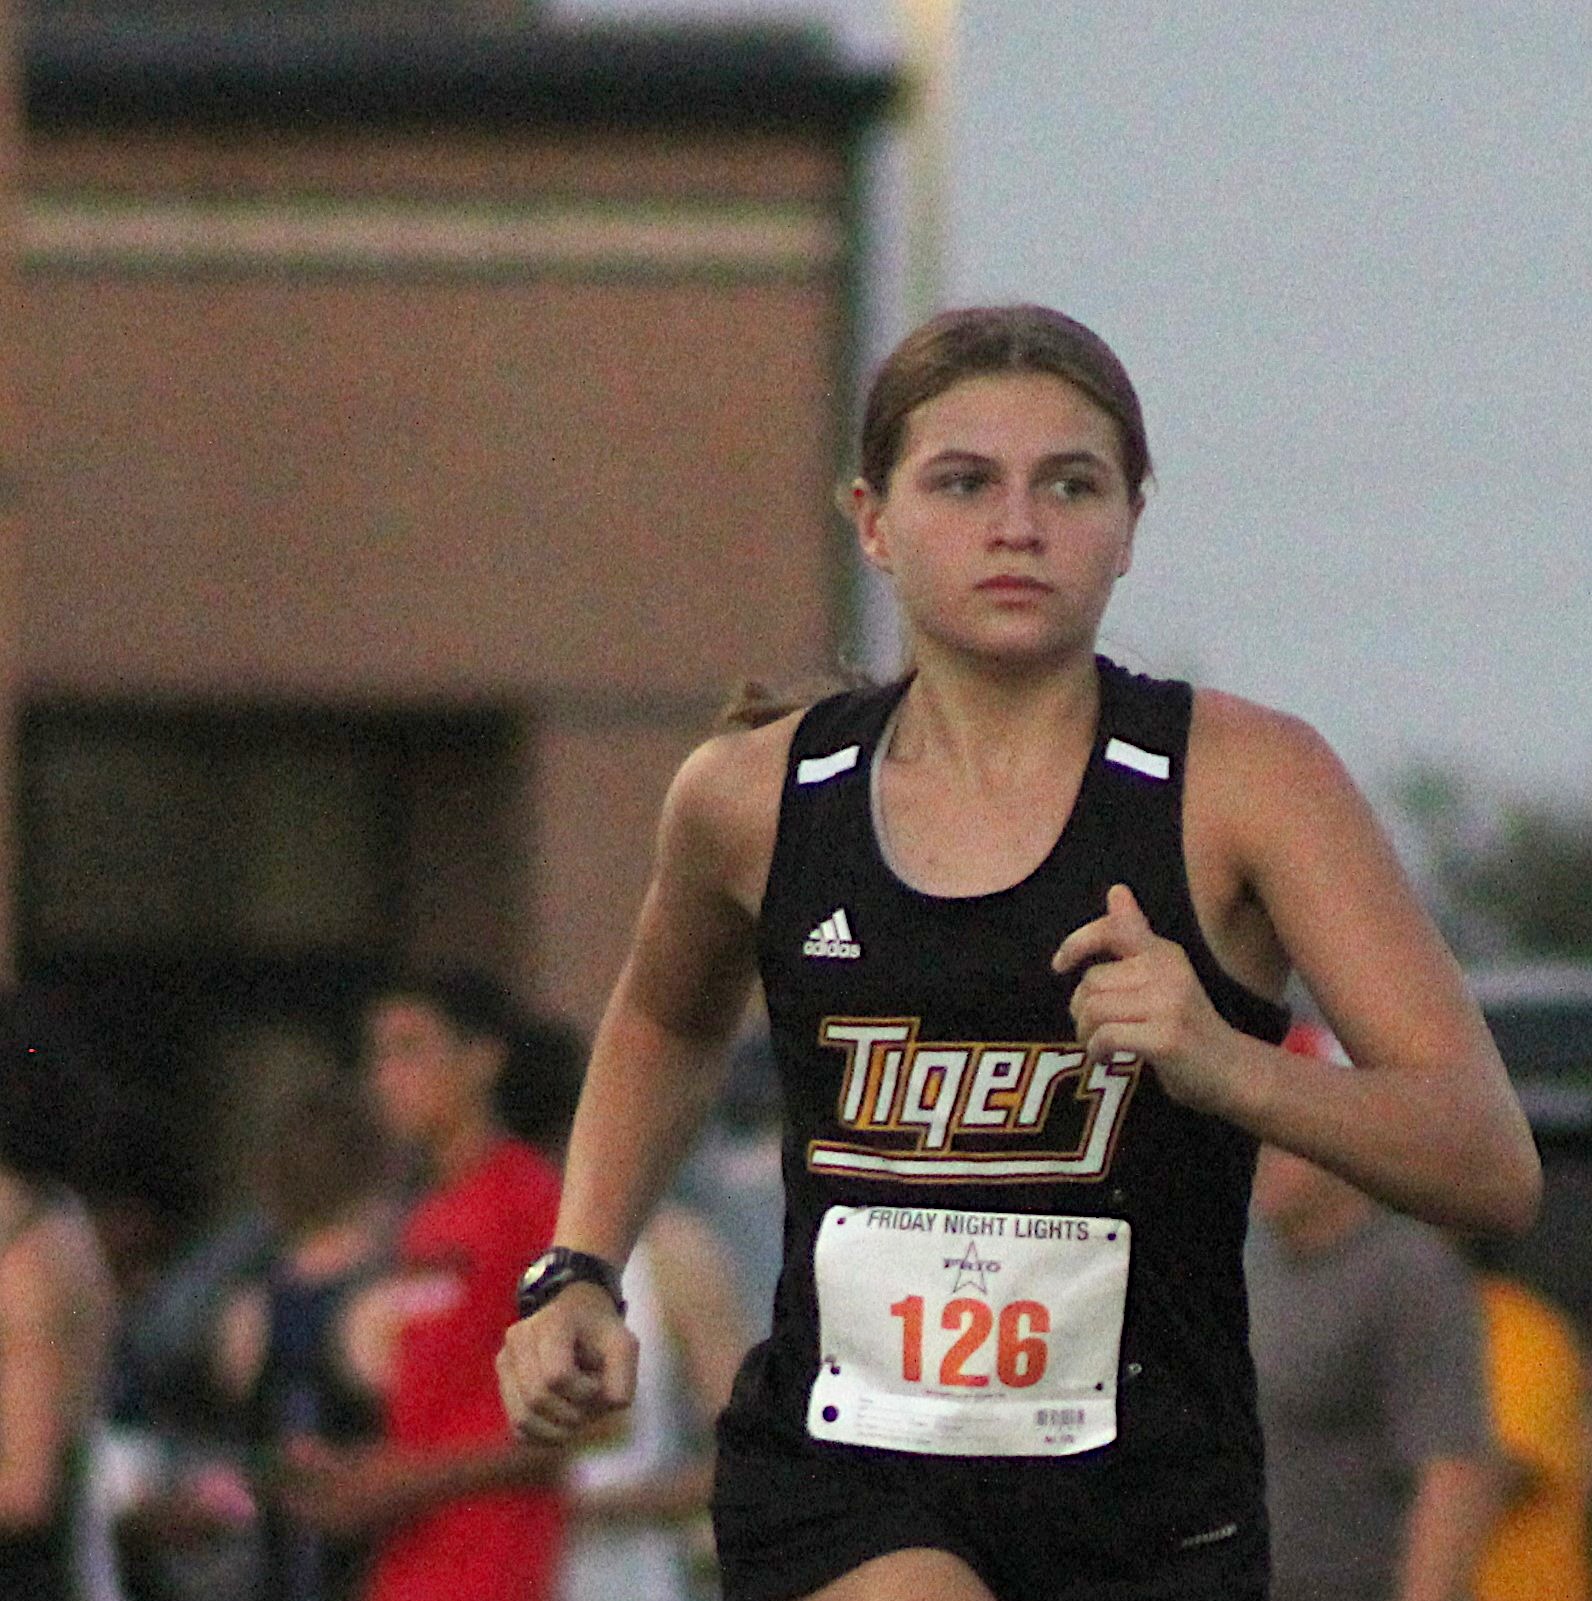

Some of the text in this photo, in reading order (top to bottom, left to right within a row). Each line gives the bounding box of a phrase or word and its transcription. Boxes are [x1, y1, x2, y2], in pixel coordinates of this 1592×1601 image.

[803, 940, 861, 959] adidas
[808, 1016, 1144, 1184] Tigers
[866, 1209, 1090, 1242] FRIDAY NIGHT LIGHTS
[889, 1294, 1052, 1389] 126
